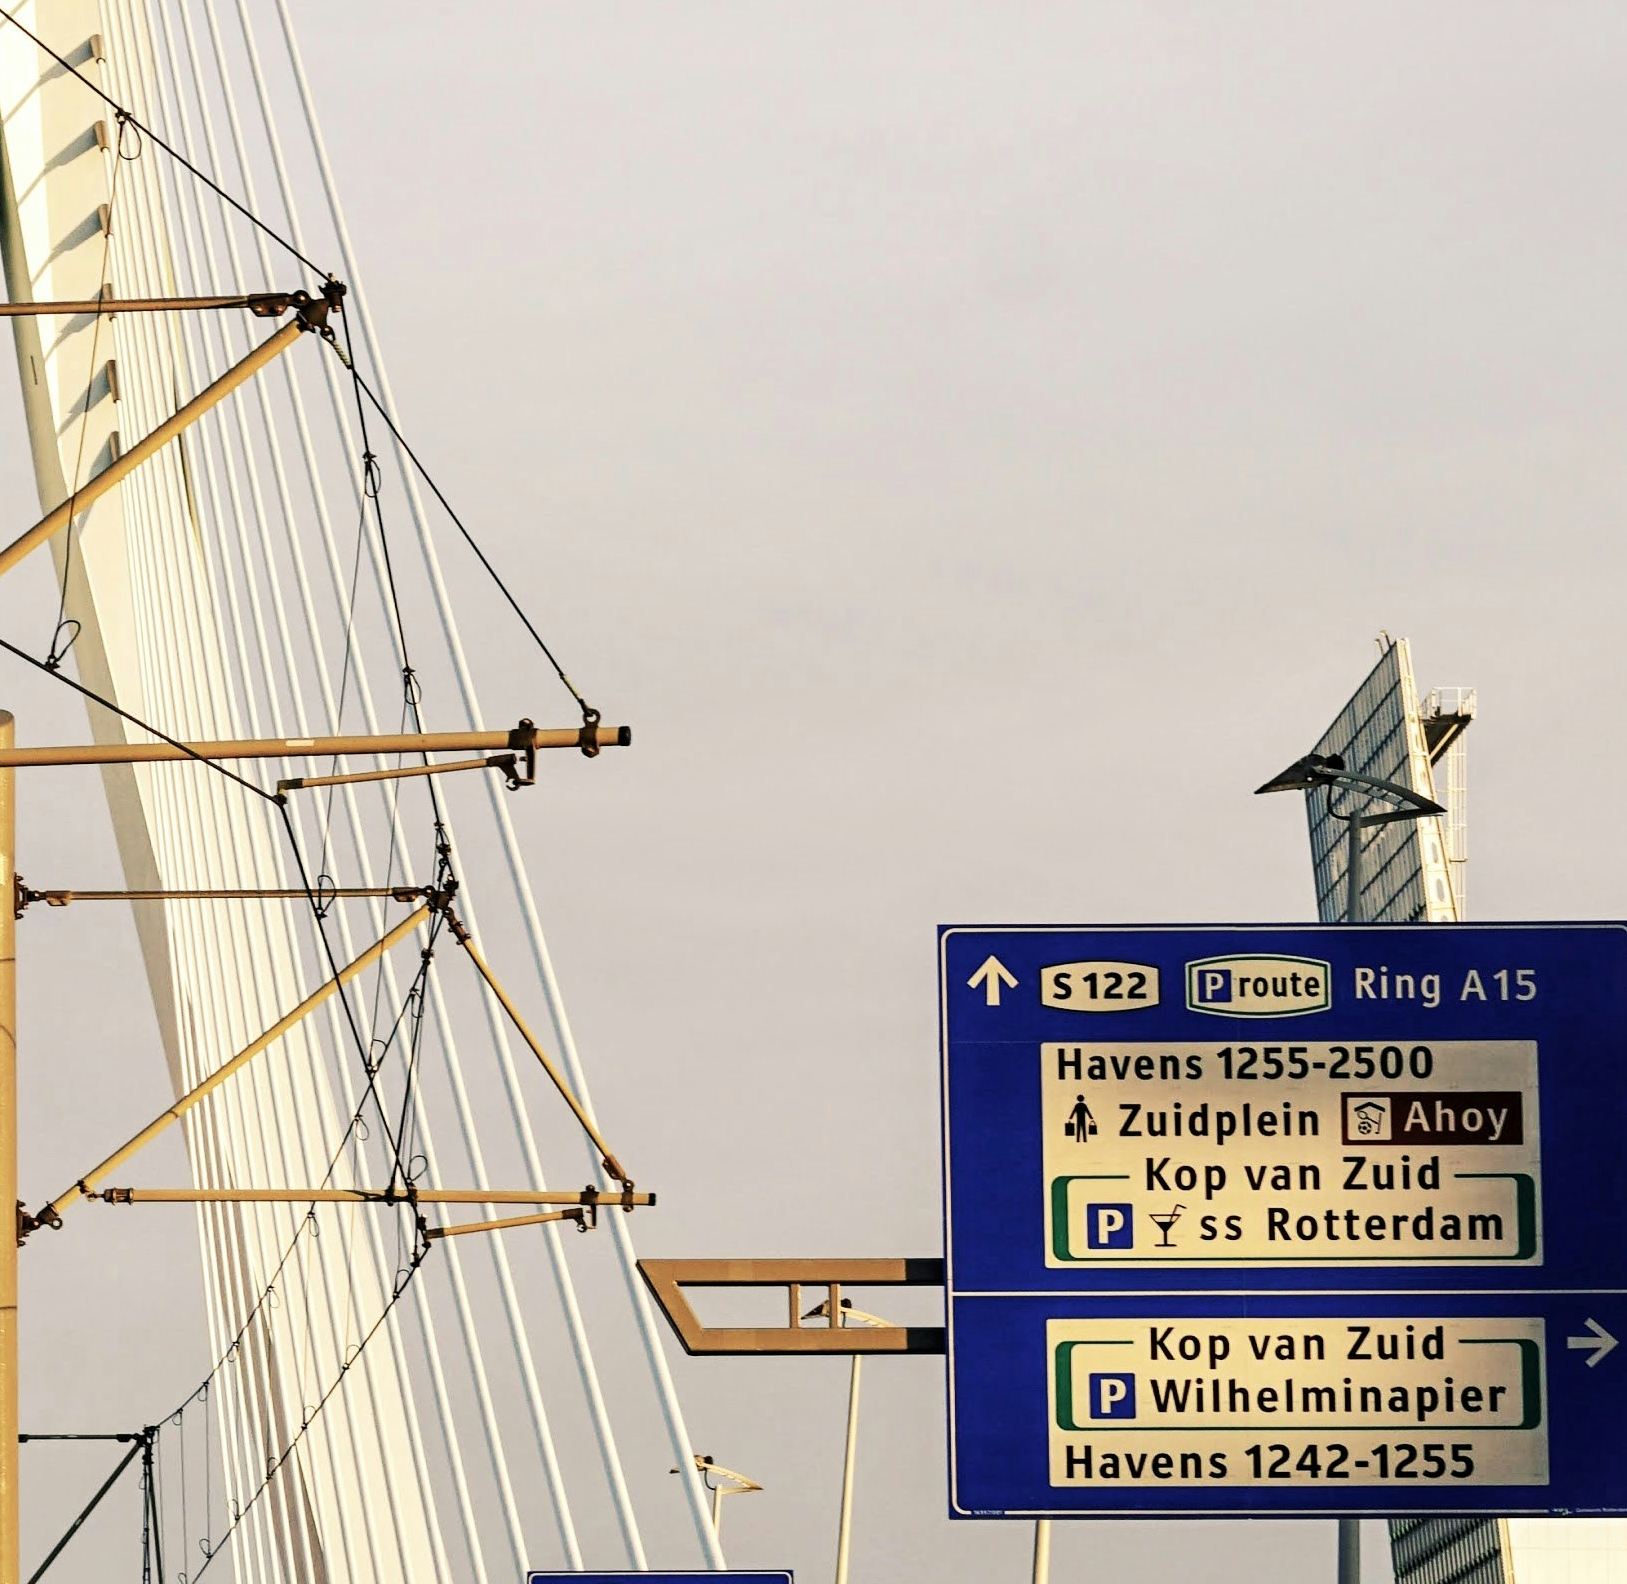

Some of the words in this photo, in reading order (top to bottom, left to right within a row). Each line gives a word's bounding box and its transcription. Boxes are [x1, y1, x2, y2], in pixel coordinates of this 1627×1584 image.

[1052, 972, 1073, 1000] S
[1082, 971, 1147, 1000] 122
[1238, 972, 1320, 997] route
[1354, 965, 1442, 1008] Ring
[1459, 969, 1537, 1001] A15
[1057, 1048, 1203, 1080] Havens
[1216, 1045, 1433, 1080] 1255-2500
[1119, 1101, 1319, 1145] Zuidplein
[1403, 1100, 1508, 1141] Ahoy
[1145, 1157, 1226, 1200] Kop
[1244, 1164, 1320, 1190] van
[1342, 1155, 1440, 1190] Zuid
[1199, 1215, 1243, 1241] ss
[1267, 1206, 1503, 1241] Rotterdam
[1149, 1326, 1230, 1369] Kop
[1248, 1334, 1324, 1360] van
[1347, 1325, 1444, 1360] Zuid
[1149, 1376, 1506, 1422] Wilhelminapier
[1065, 1445, 1228, 1479] Havens
[1244, 1443, 1474, 1479] 1242-1255
